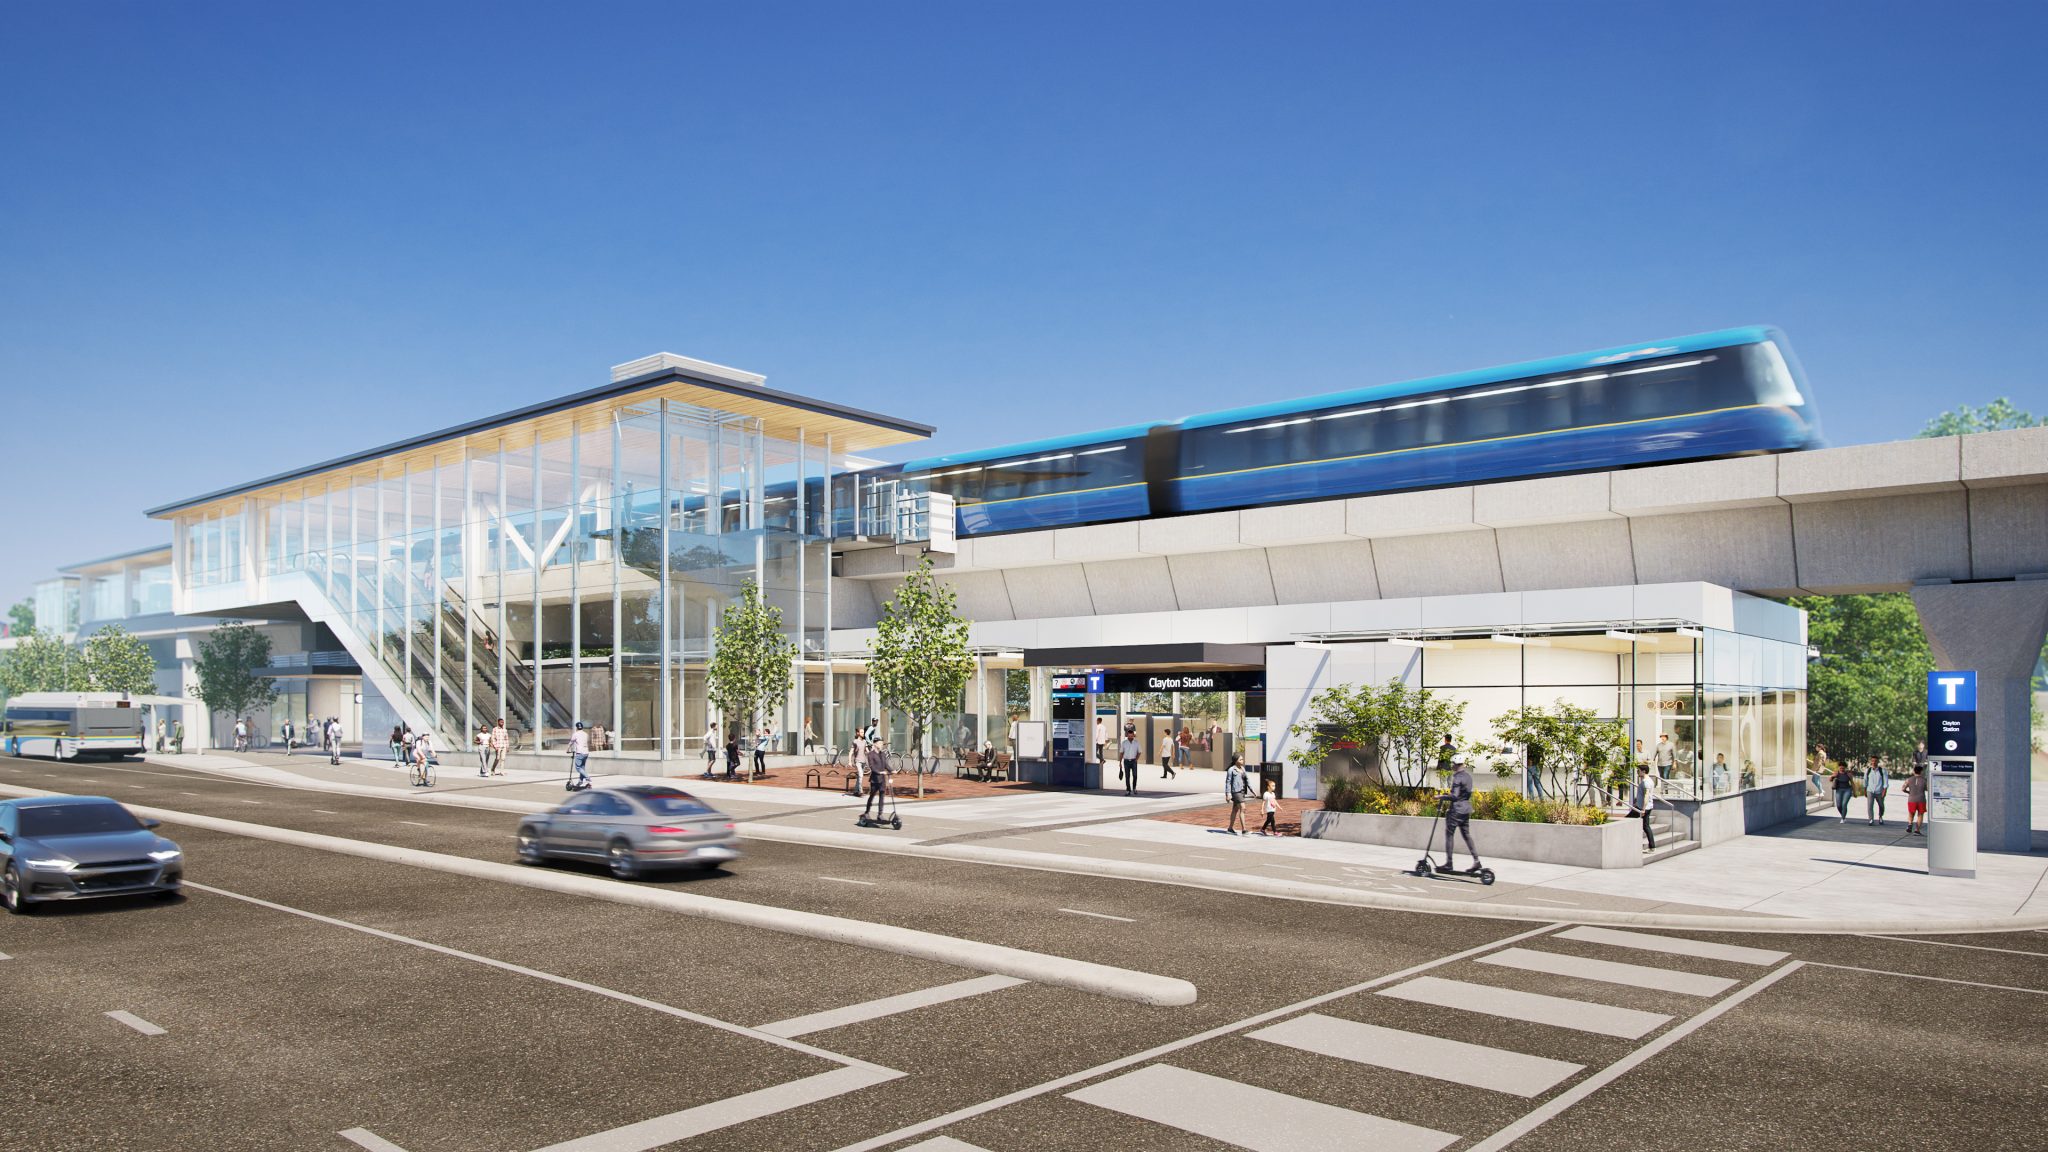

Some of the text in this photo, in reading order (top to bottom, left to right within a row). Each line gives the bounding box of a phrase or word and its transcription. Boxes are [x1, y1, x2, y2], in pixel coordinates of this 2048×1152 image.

[1090, 676, 1100, 690] T
[1149, 676, 1214, 690] Clayton Station
[1937, 677, 1965, 705] T
